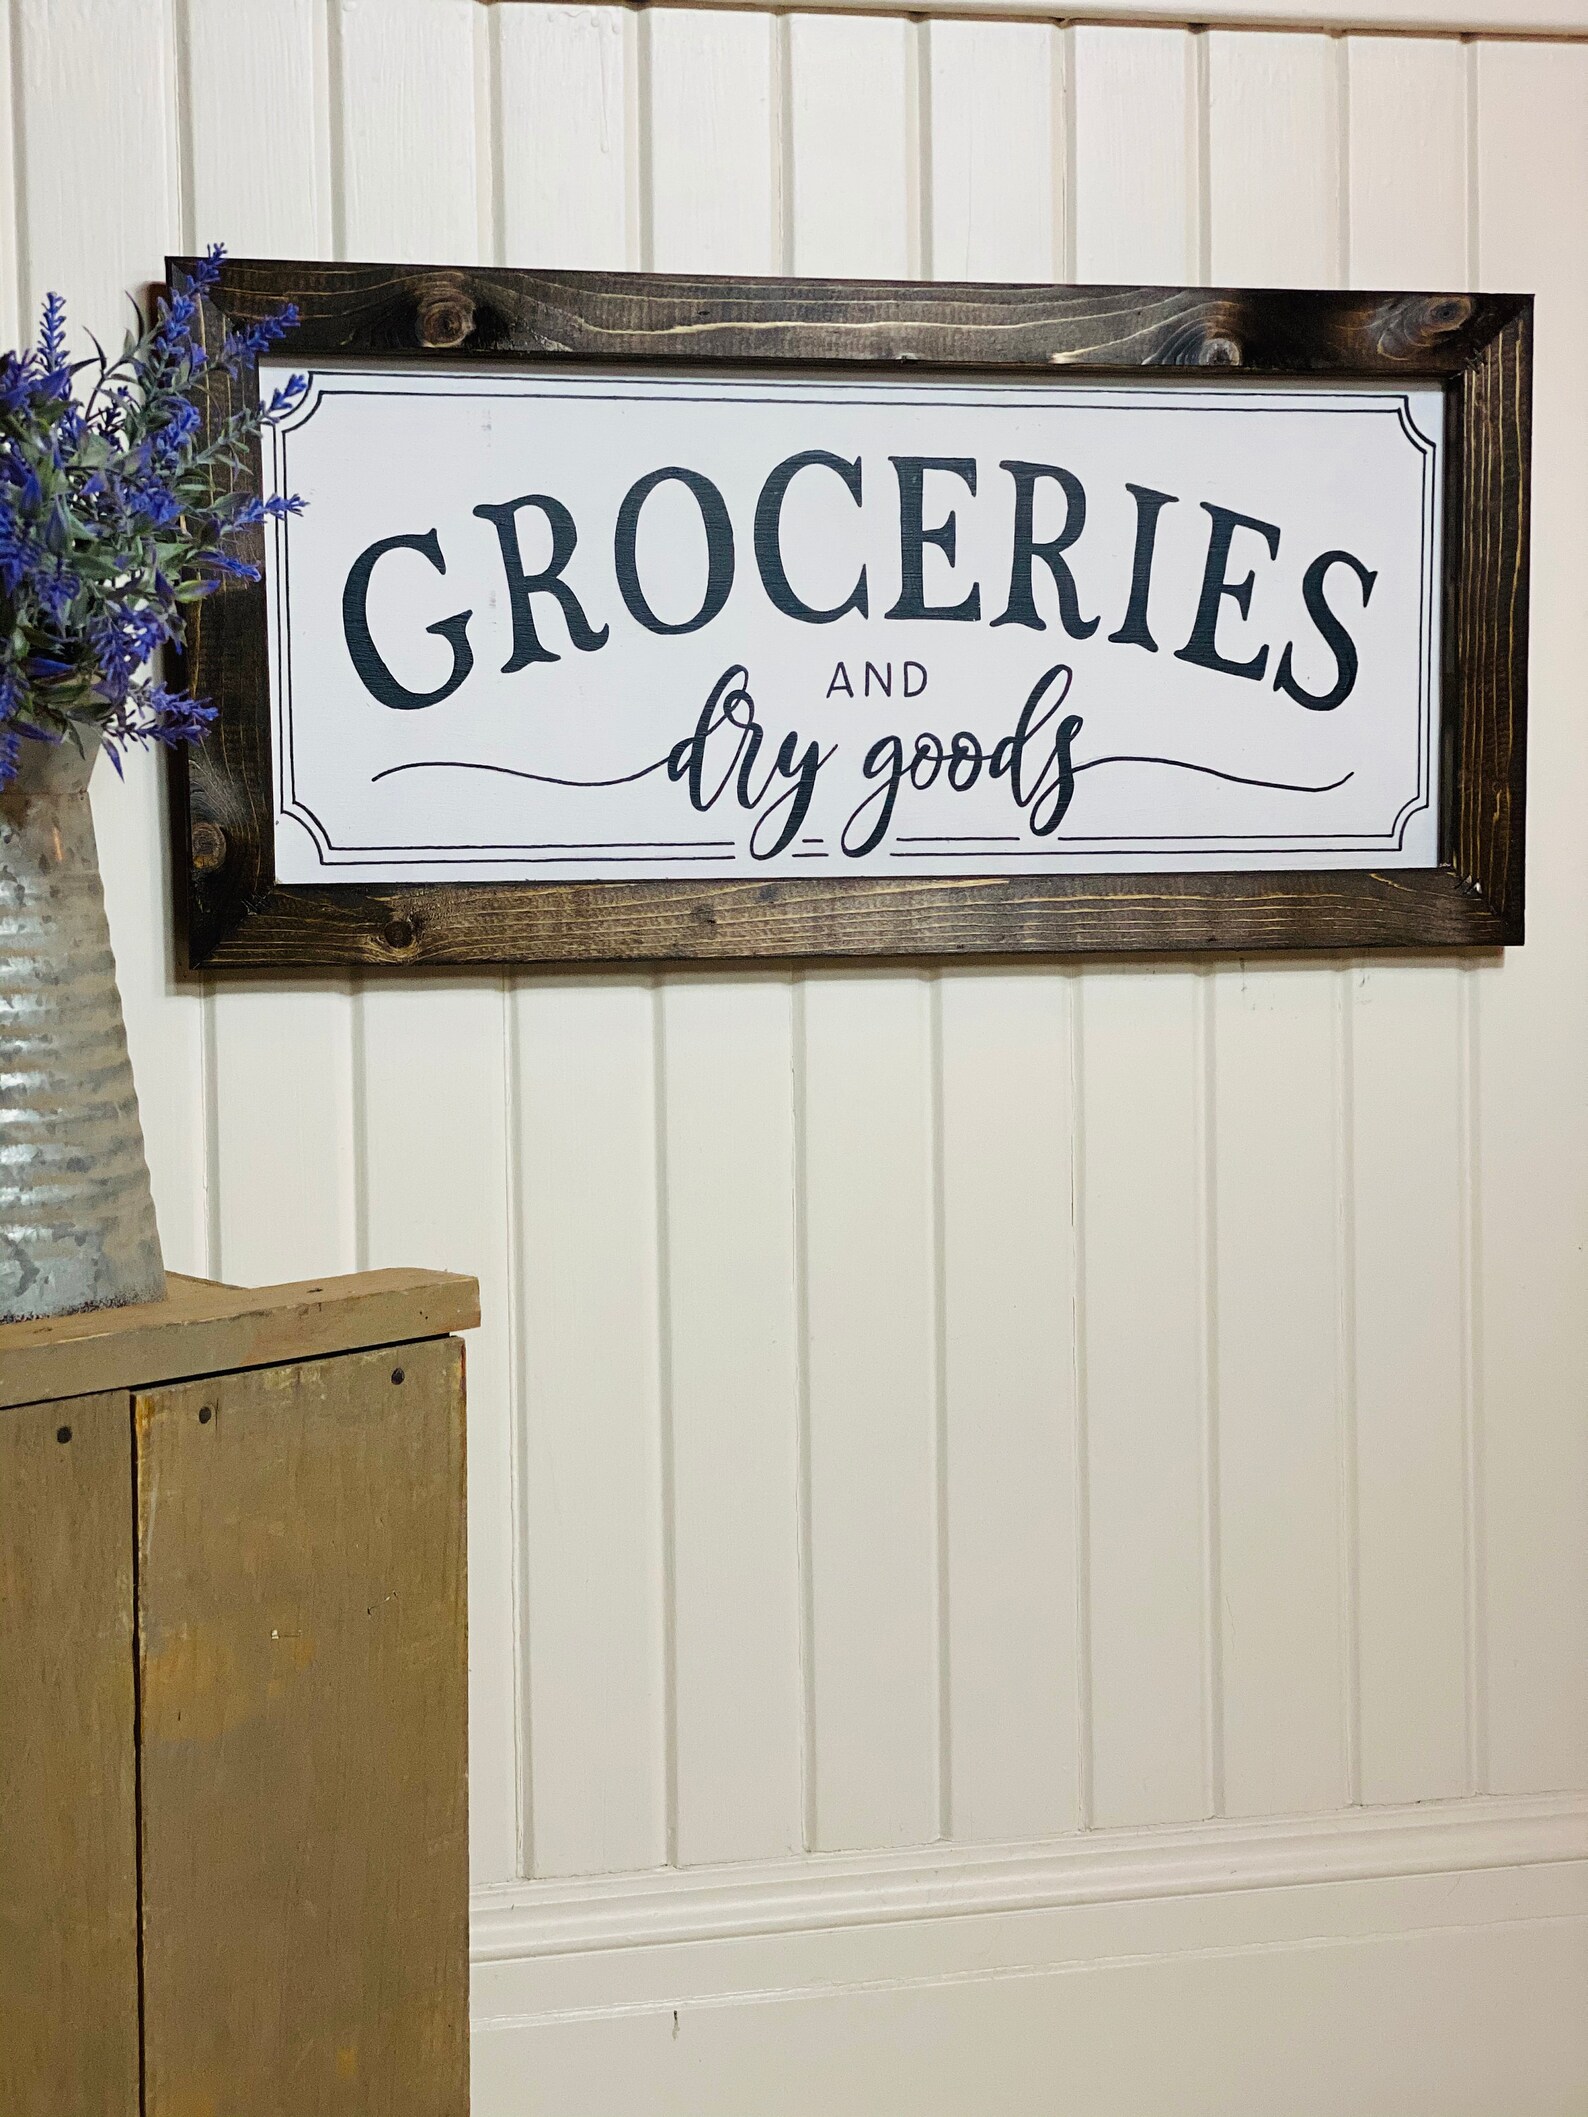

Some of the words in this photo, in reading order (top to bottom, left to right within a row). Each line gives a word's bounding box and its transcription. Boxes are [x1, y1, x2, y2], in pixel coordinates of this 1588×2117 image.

[342, 449, 1379, 712] GROCERIES
[826, 660, 929, 699] AND
[666, 664, 839, 861] dry
[840, 663, 1084, 859] goods
